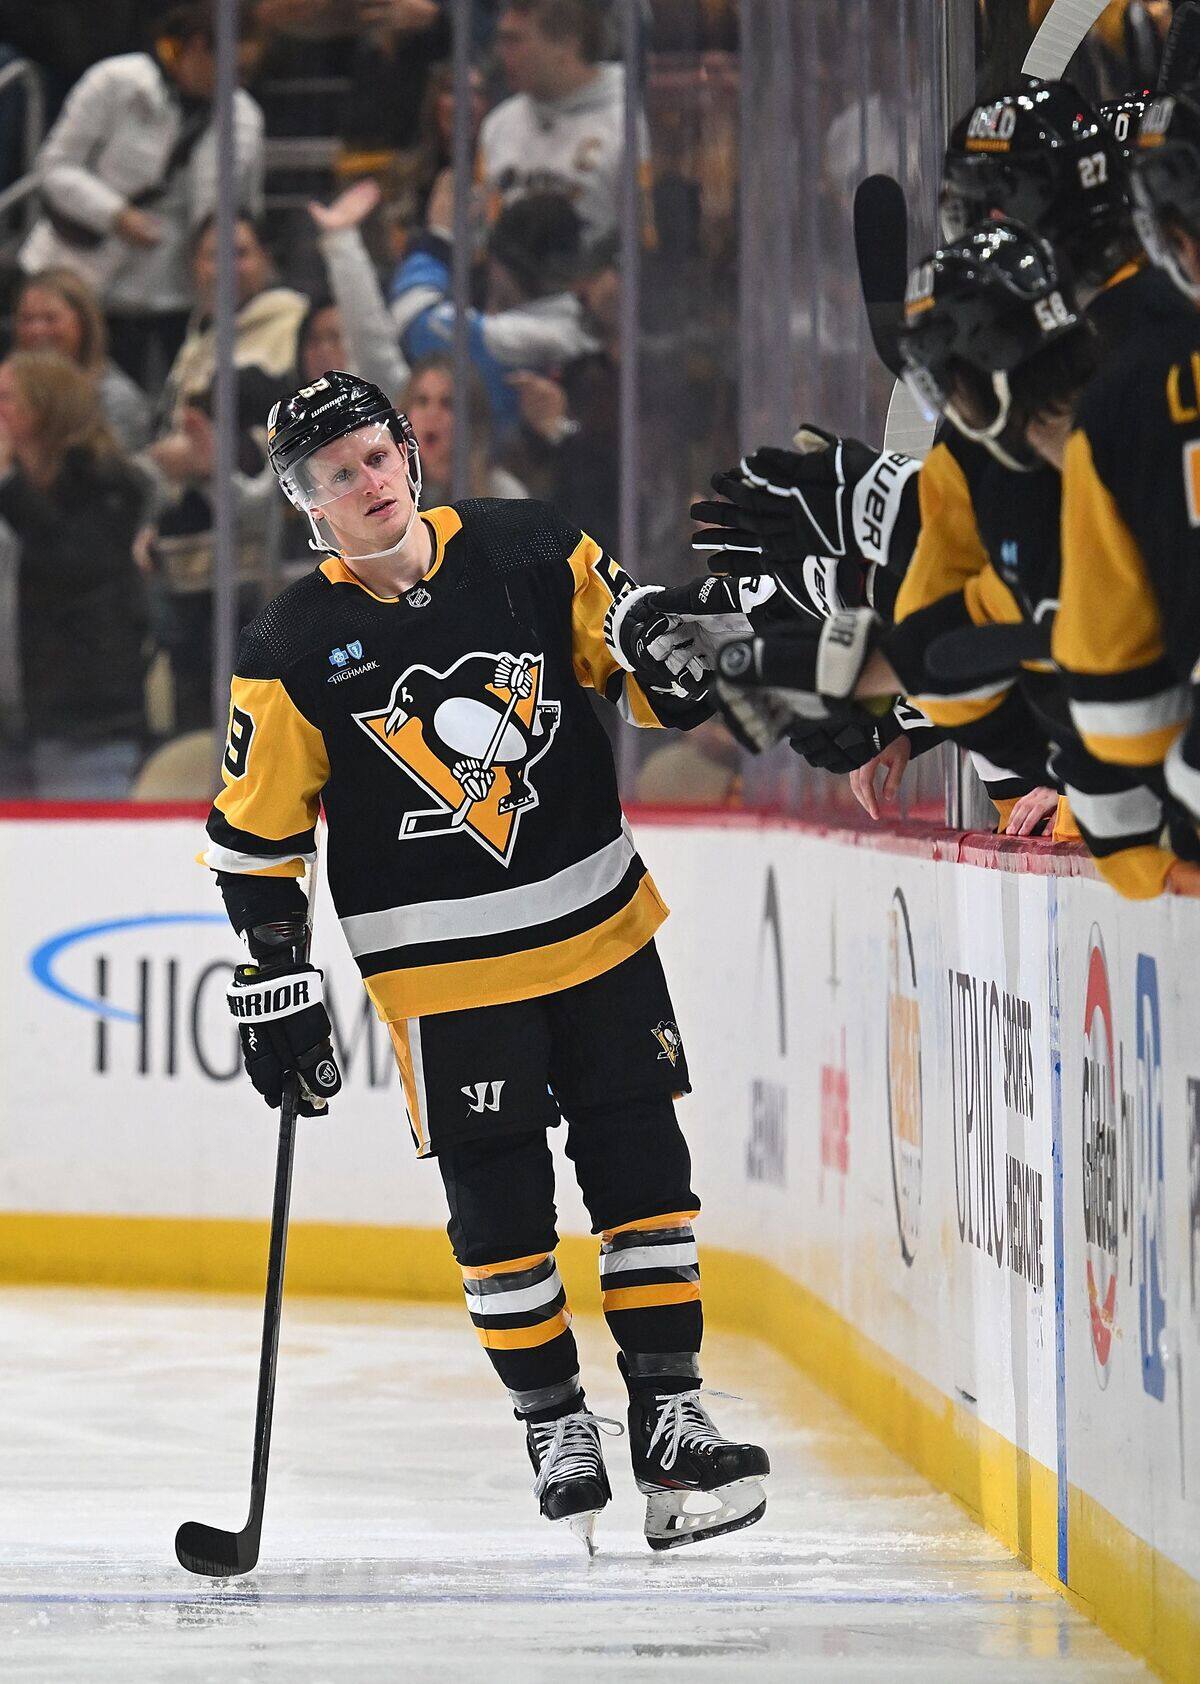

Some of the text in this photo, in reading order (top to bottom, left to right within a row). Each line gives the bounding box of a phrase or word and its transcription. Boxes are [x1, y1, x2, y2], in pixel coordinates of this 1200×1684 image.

[1077, 151, 1108, 189] 27
[310, 393, 348, 418] WARRIOR
[330, 660, 379, 685] HIGHMARK
[226, 980, 310, 1017] RRIOR
[1002, 990, 1035, 1122] SPORTS
[948, 968, 1004, 1269] UPMC
[1005, 1153, 1044, 1288] MEDICINE
